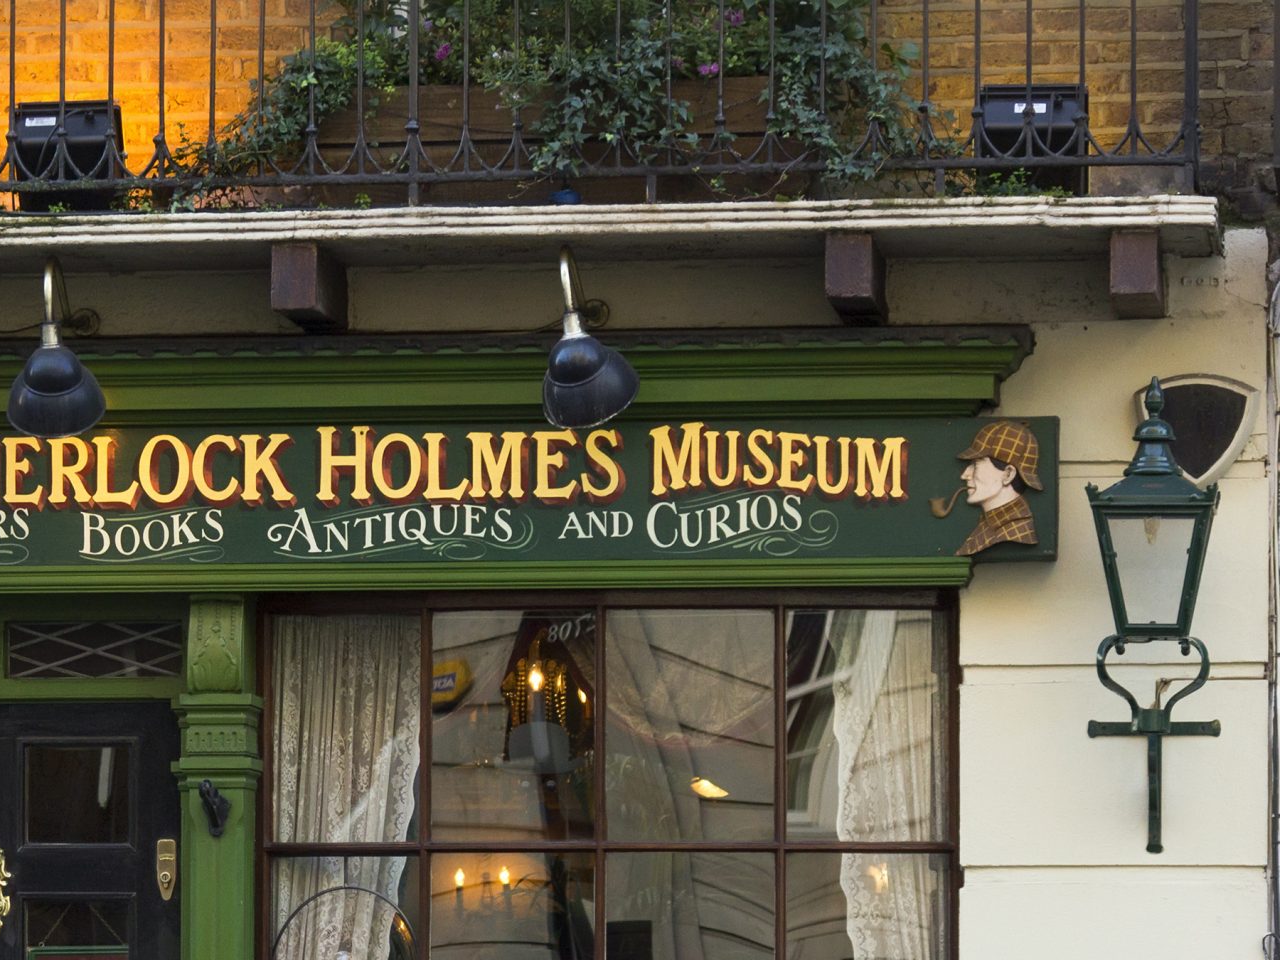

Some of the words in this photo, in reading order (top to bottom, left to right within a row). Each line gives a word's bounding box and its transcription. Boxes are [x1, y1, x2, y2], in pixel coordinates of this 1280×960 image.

[316, 426, 622, 503] HOLMES
[649, 421, 909, 499] MUSEUM
[79, 509, 224, 556] BOOKS
[267, 504, 513, 553] ANTIQUES
[558, 511, 634, 540] AND
[645, 495, 803, 548] CURIOS
